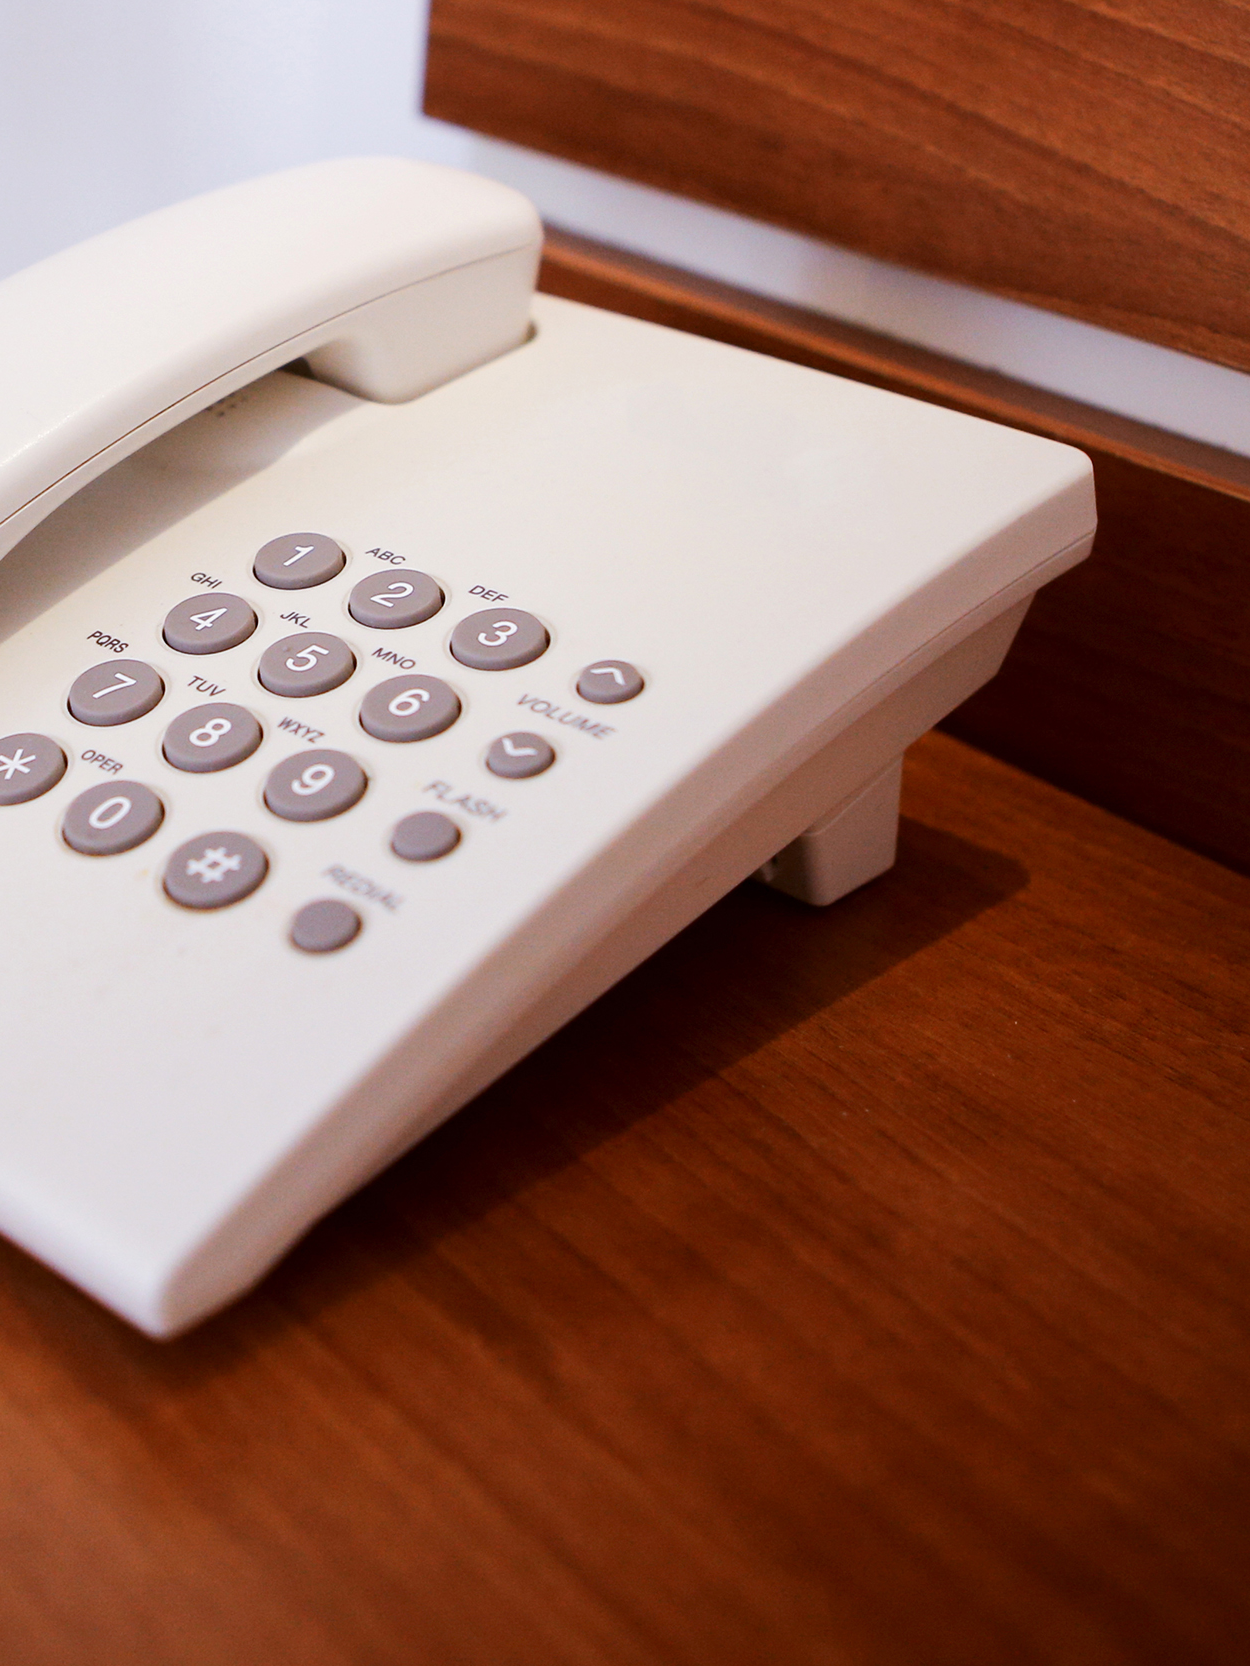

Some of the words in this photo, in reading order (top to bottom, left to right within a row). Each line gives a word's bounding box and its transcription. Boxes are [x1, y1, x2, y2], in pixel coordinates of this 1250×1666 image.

[283, 545, 314, 566] 1
[365, 547, 405, 565] ABC
[191, 572, 222, 589] GHI
[370, 582, 414, 608] 2
[468, 585, 509, 602] DEF
[189, 607, 227, 631] 4
[280, 611, 312, 628] JKL
[87, 630, 129, 653] PQRS
[478, 621, 518, 646] 3
[285, 644, 329, 672] 5
[372, 647, 416, 670] MNO
[92, 672, 137, 699] 7
[187, 675, 226, 697] TUV
[388, 688, 430, 716] 6
[516, 694, 617, 739] VOLUME
[189, 718, 232, 747] 8
[277, 717, 325, 743] WXYZ
[81, 750, 123, 775] OPER
[291, 764, 335, 795] 9
[88, 796, 132, 829] 0
[422, 780, 507, 822] FLASH
